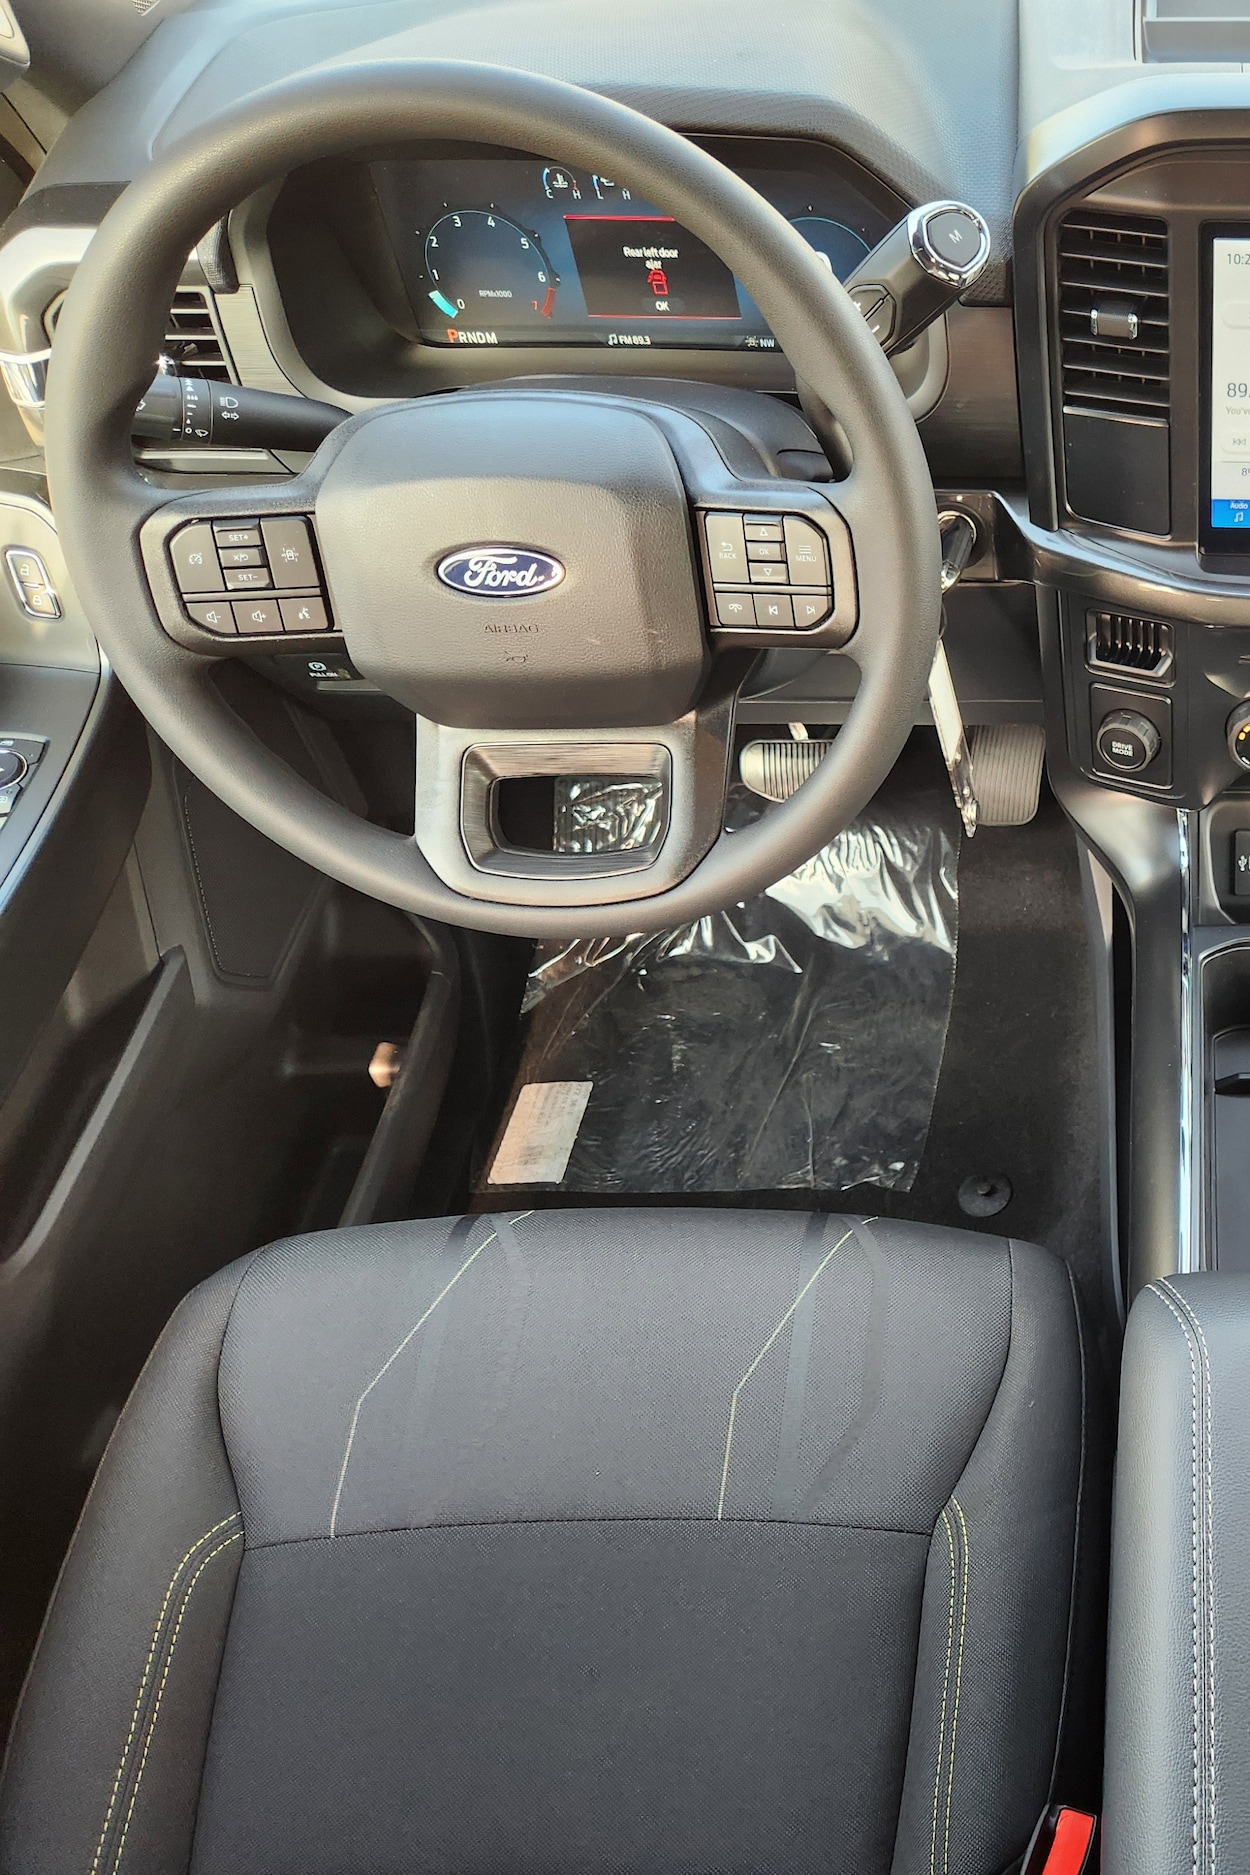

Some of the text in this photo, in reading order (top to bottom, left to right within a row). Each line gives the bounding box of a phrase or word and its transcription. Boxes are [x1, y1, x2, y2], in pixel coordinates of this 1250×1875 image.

[546, 190, 553, 199] C
[573, 190, 582, 200] H
[596, 190, 604, 200] L
[622, 190, 631, 200] H
[453, 216, 462, 228] 3
[487, 216, 496, 228] 4
[430, 236, 439, 248] 2
[948, 230, 963, 244] M
[521, 238, 530, 249] 5
[622, 246, 678, 258] Rear left door
[645, 260, 662, 270] ajar
[432, 269, 440, 280] 1
[538, 271, 546, 283] 6
[457, 298, 466, 310] 0
[532, 300, 538, 310] 7
[655, 301, 669, 312] OK
[618, 335, 651, 346] FM 89.3
[760, 338, 775, 348] NW
[1230, 502, 1248, 510] Audio
[463, 554, 538, 588] Ford
[483, 624, 539, 634] AIRBAG
[1112, 741, 1133, 750] DRIVE
[1112, 748, 1134, 757] MODE
